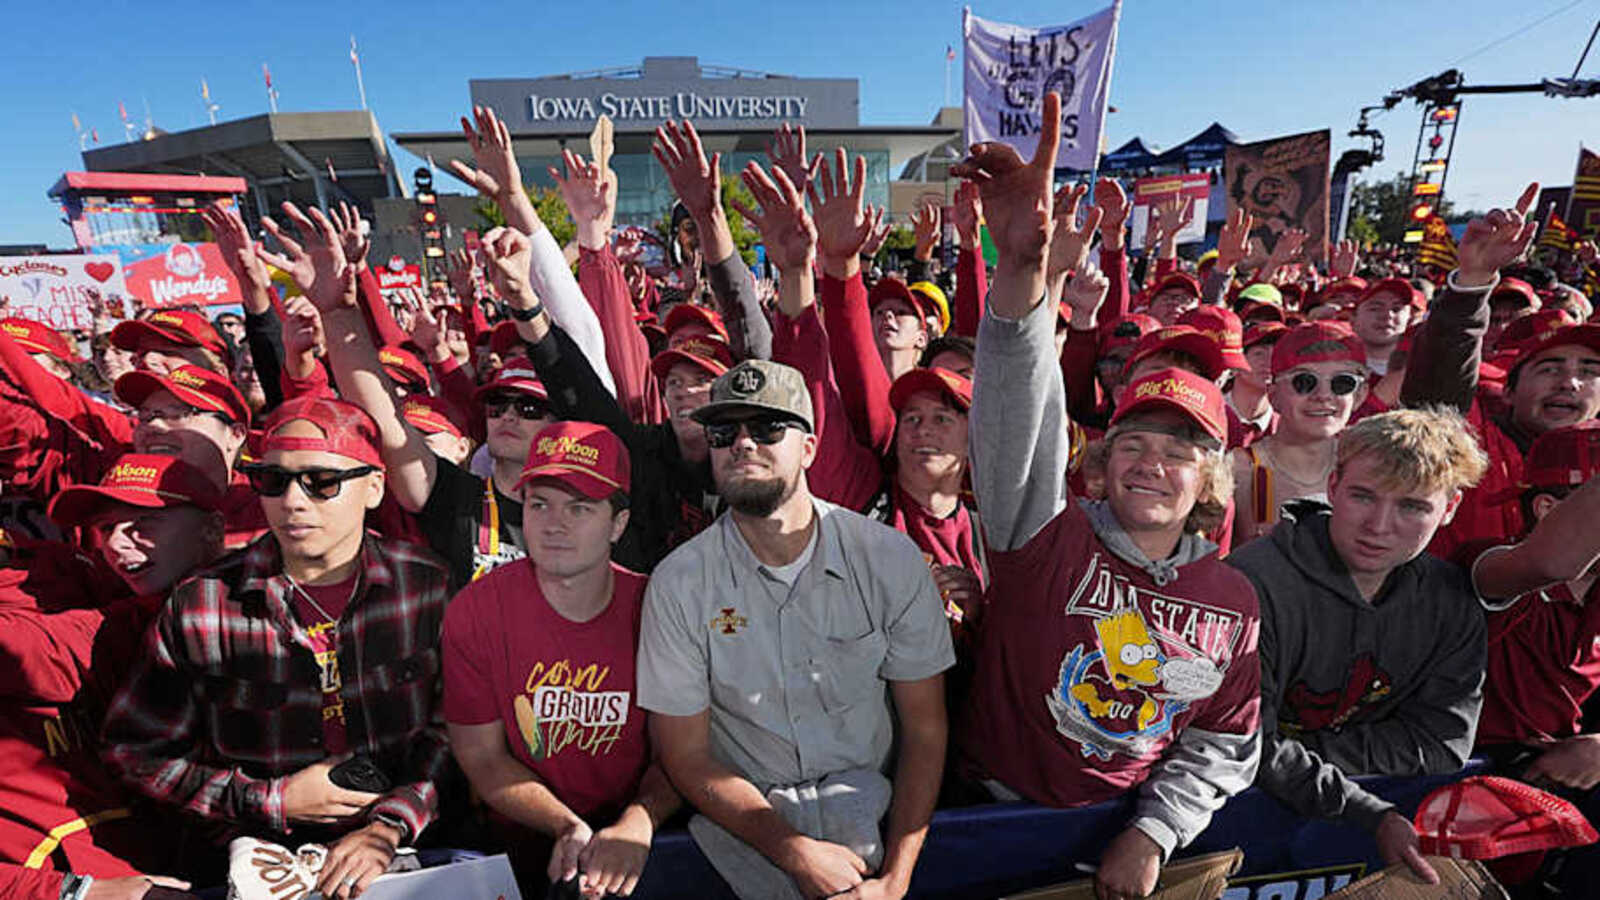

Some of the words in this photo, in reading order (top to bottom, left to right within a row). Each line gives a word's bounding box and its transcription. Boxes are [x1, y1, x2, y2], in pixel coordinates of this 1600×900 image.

[530, 95, 597, 121] IOWA
[601, 92, 671, 119] STATE
[676, 92, 809, 119] UNIVERSITY
[999, 111, 1079, 139] HAWS
[150, 272, 228, 304] Wendy's
[1163, 378, 1206, 403] Noon
[558, 436, 599, 460] Noon
[1150, 598, 1232, 661] STATE
[541, 689, 623, 722] GROWS
[546, 713, 621, 759] IOWA
